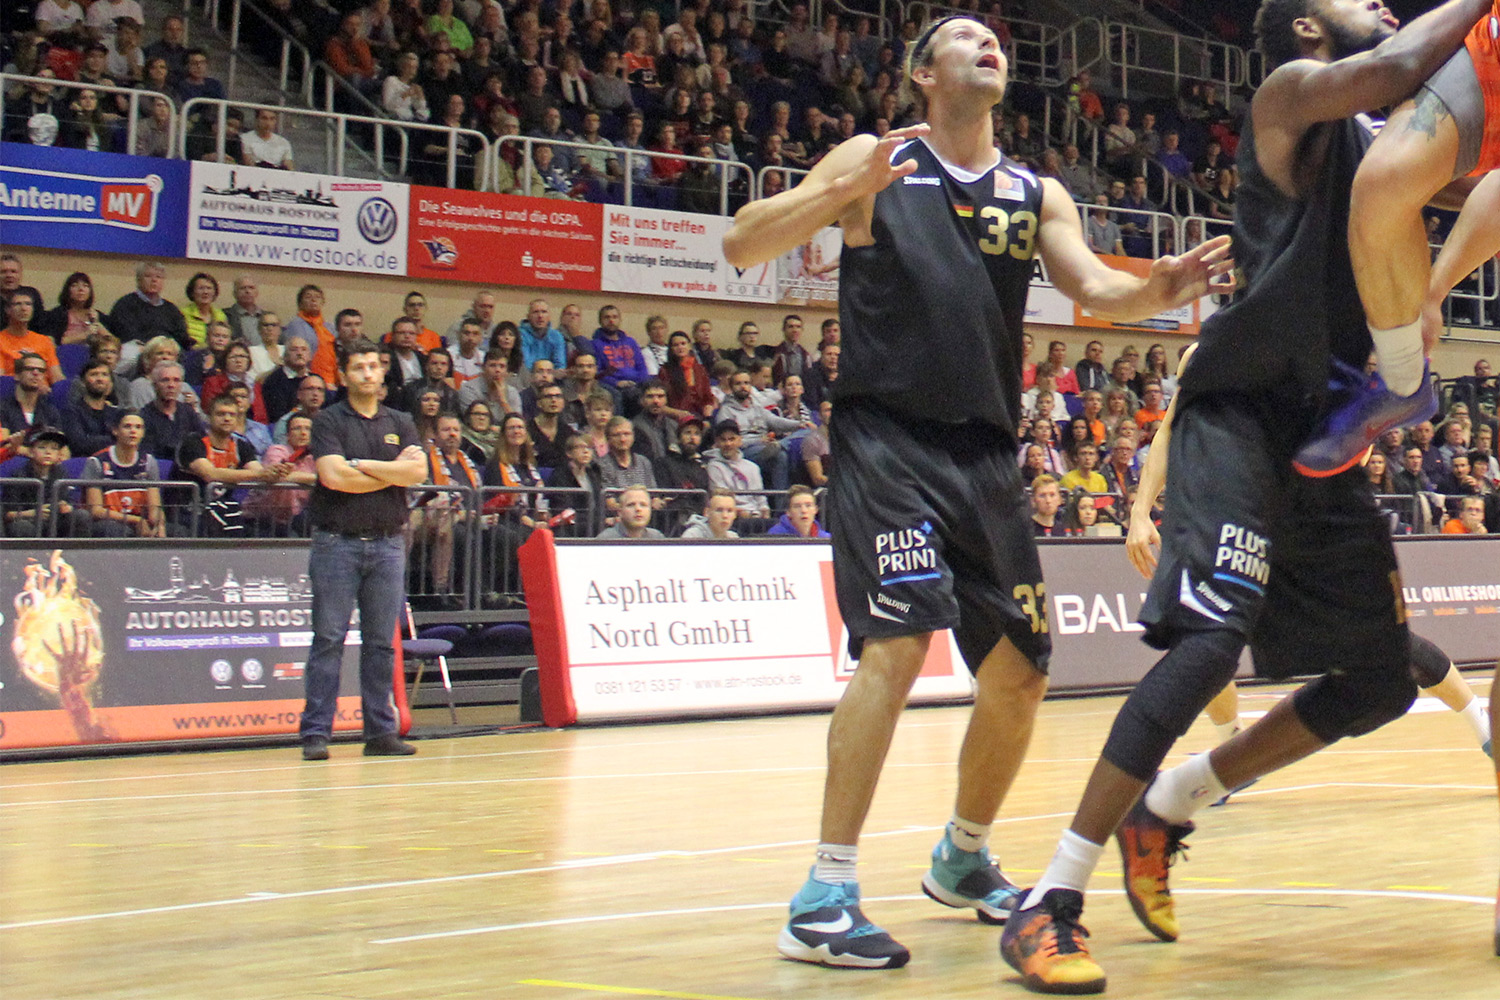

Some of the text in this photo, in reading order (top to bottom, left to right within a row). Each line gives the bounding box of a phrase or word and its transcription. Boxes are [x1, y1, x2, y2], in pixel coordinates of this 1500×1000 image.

[0, 183, 144, 217] Antenne MV
[201, 200, 339, 221] AUTOHAUS ROSTOCK
[419, 200, 440, 213] Die
[442, 201, 502, 219] Seawolves
[505, 210, 527, 221] und
[530, 210, 548, 224] die
[610, 213, 706, 235] Mit uns treffen
[978, 206, 1037, 261] 33
[610, 230, 687, 250] Sie immer...
[197, 240, 397, 269] www.vw-rostock.de
[608, 252, 621, 263] die
[624, 253, 656, 266] richtige
[875, 528, 926, 553] PLUS
[1219, 523, 1267, 558] PLUS
[585, 576, 798, 611] Asphalt Technik
[877, 593, 911, 613] SPALDING
[125, 610, 254, 629] AUTOHAUS
[1054, 593, 1147, 634] BAL
[589, 618, 754, 649] Nord GmbH
[594, 681, 624, 695] 0381
[628, 680, 647, 693] 121
[650, 679, 666, 692] 53
[668, 678, 682, 691] 57
